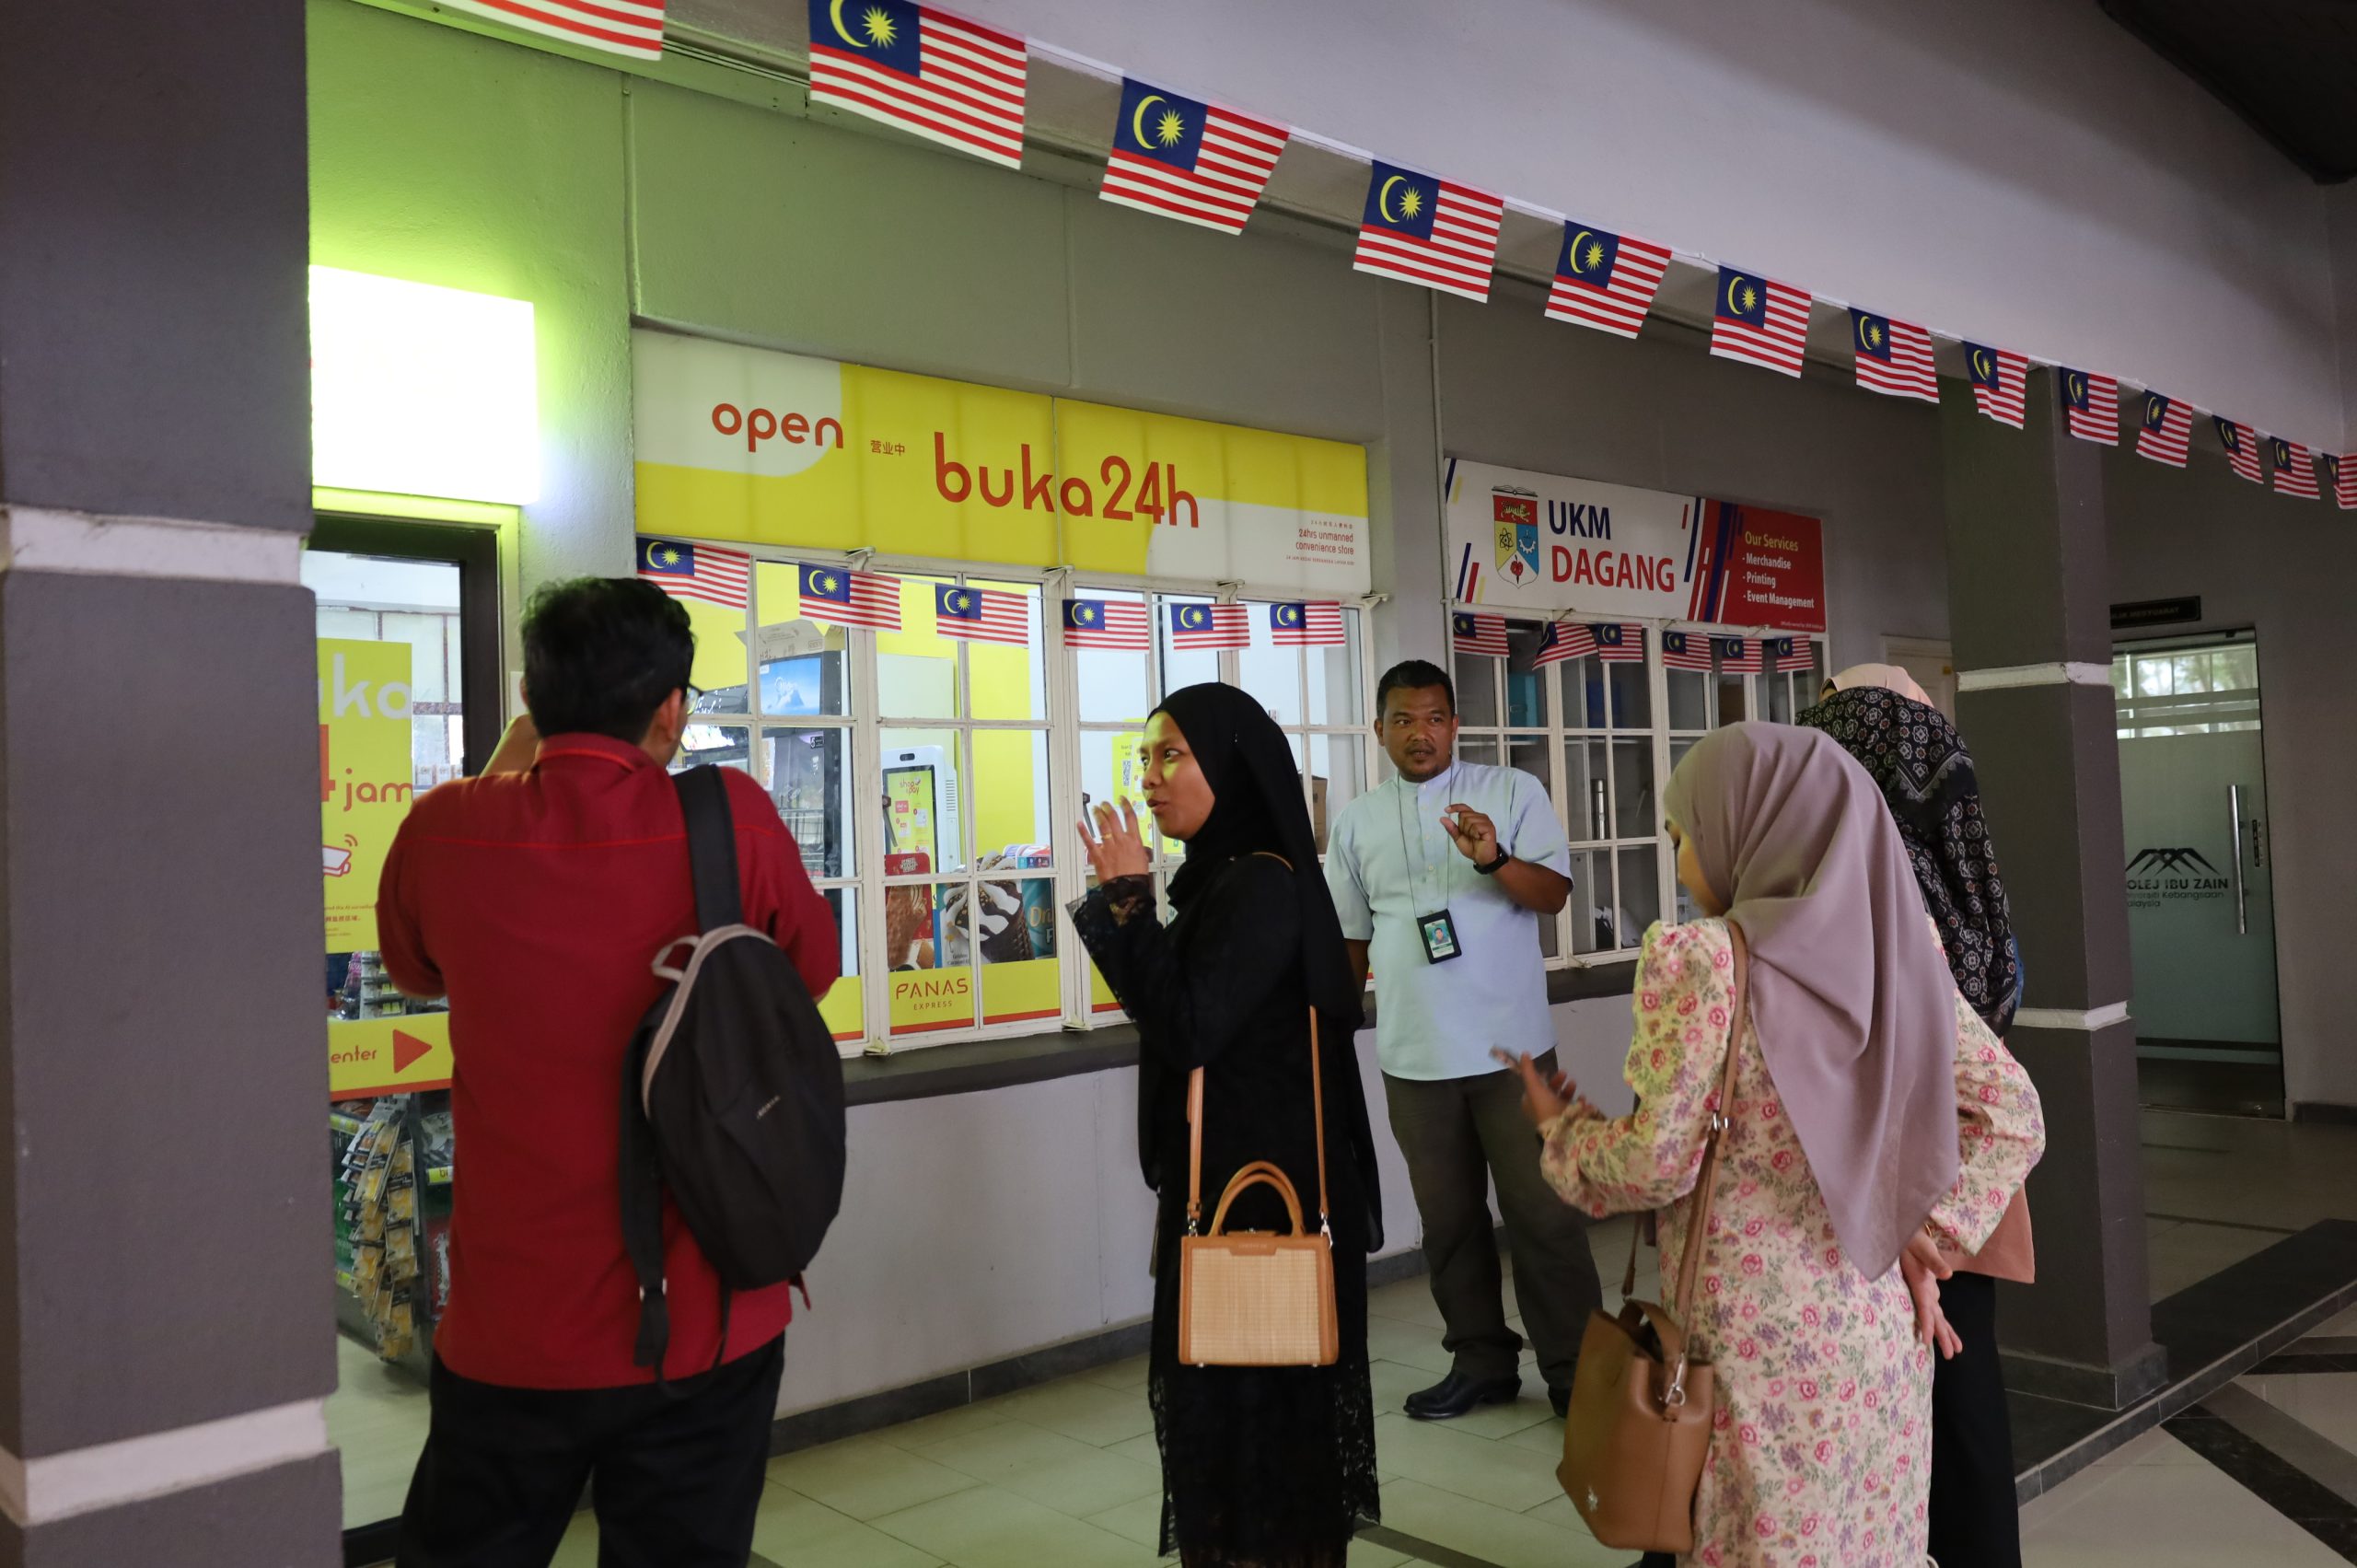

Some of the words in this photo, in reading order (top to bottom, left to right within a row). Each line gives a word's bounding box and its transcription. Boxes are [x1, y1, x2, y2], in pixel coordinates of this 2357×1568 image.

[712, 403, 843, 452] open
[870, 440, 905, 456] 营业中
[935, 432, 1199, 528] buka24h
[1549, 500, 1611, 540] UKM
[1299, 528, 1317, 539] 24hrs
[1318, 533, 1353, 542] unmanned
[1745, 531, 1761, 545] Our
[1763, 534, 1798, 552] Services
[1296, 541, 1336, 553] convenience
[1339, 545, 1353, 555] store
[1552, 545, 1675, 592] DAGANG
[1746, 552, 1791, 569] Merchandise
[1747, 572, 1776, 588] Printing
[1747, 590, 1768, 603] Event
[1769, 593, 1814, 609] Management
[2127, 878, 2159, 889] OLEJ
[2165, 878, 2189, 889] IBU
[2193, 877, 2228, 889] ZAIN
[2162, 891, 2224, 900] Kebangsaan
[2127, 900, 2161, 909] alaysia
[896, 978, 968, 1000] PANAS
[913, 1000, 952, 1011] EXPRESS
[331, 1045, 377, 1063] enter
